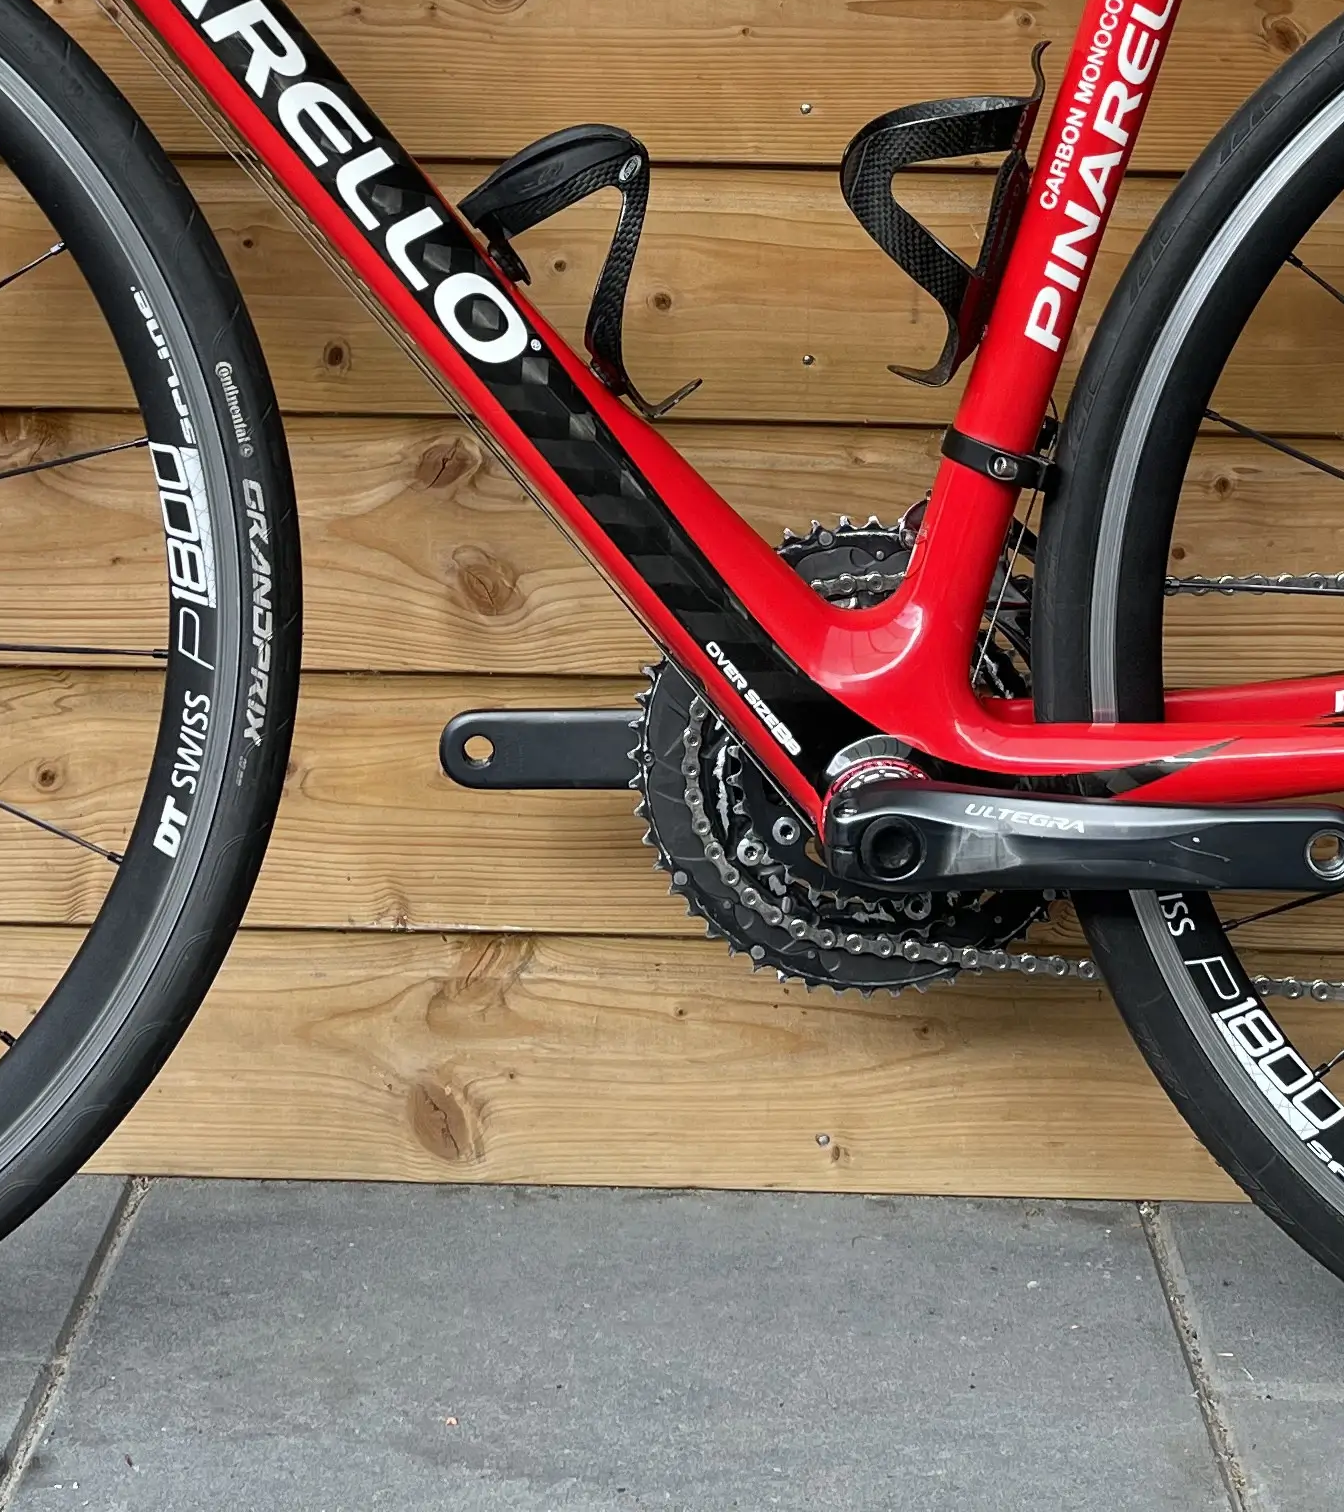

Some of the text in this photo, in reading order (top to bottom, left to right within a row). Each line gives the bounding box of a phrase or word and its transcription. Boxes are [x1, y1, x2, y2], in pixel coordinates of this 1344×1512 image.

[1039, 108, 1081, 211] CARBON
[215, 361, 252, 443] Continental
[148, 440, 216, 670] P1800
[705, 640, 749, 690] OVER
[153, 689, 211, 859] DT SWISS
[964, 802, 1086, 834] ULTEGRA
[1159, 892, 1195, 938] ISS
